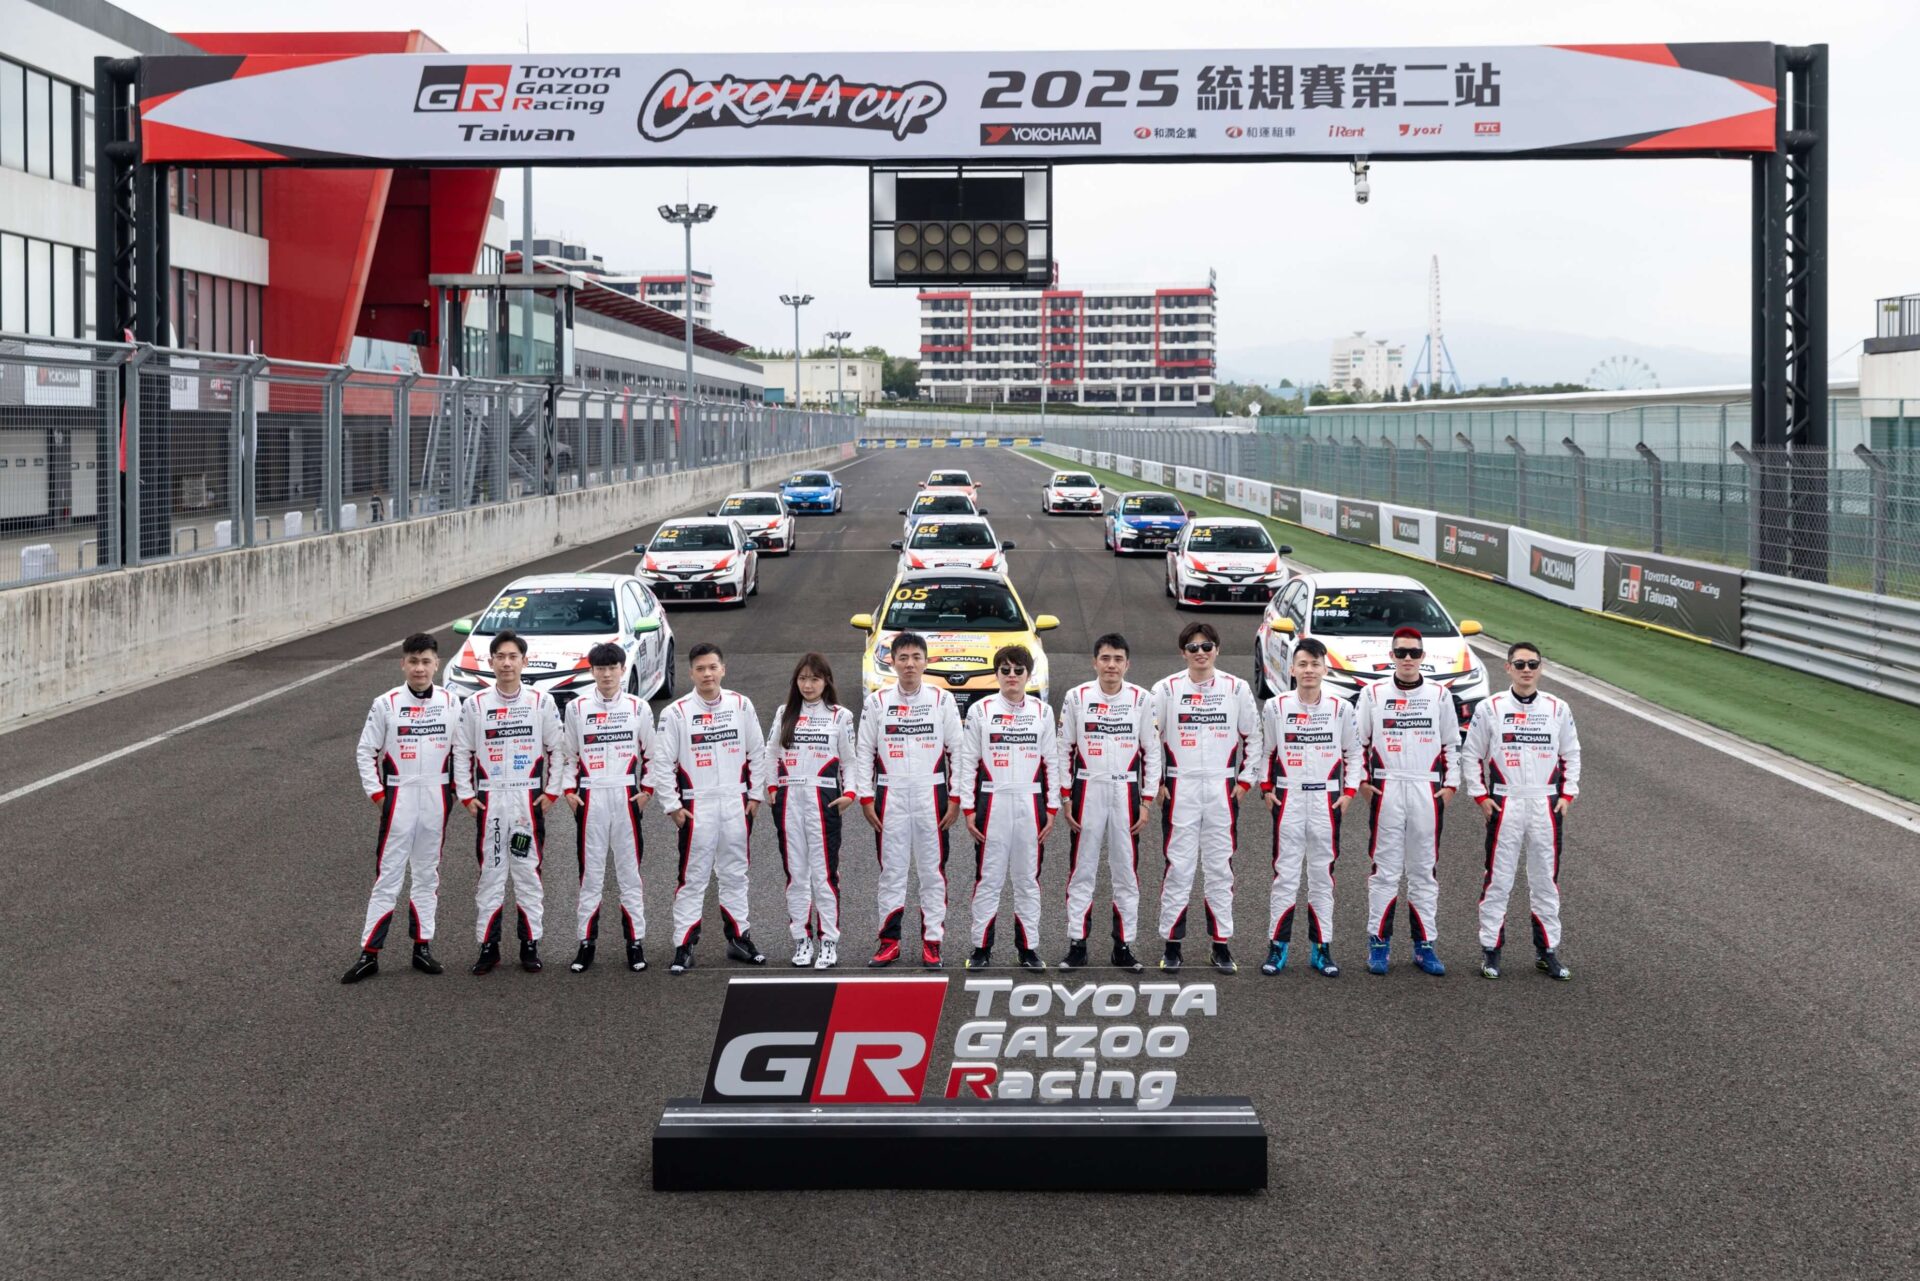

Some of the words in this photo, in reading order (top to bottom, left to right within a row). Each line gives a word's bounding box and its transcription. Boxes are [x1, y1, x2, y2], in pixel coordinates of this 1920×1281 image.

[520, 66, 621, 79] TOYOTA
[418, 83, 504, 110] GR
[516, 82, 609, 95] GAZOO
[980, 69, 1179, 109] 2025
[1196, 62, 1501, 112] 統規賽第二站
[512, 97, 605, 115] Racing
[641, 72, 841, 139] COROLLA
[848, 83, 943, 135] CUP
[458, 124, 575, 142] Taiwan
[1011, 127, 1097, 142] YOKOHAMA
[1412, 123, 1443, 136] yoxi
[896, 588, 928, 600] 05
[1620, 579, 1639, 601] GR
[1644, 570, 1669, 583] TOYOTA
[1695, 581, 1720, 599] Racing
[493, 596, 528, 609] 33
[1314, 595, 1349, 608] 24
[1644, 586, 1677, 608] Taiwan
[498, 728, 531, 736] YOKOHAMA
[964, 979, 1217, 1017] TOYOTA
[954, 1021, 1190, 1058] GAZOO
[714, 1031, 926, 1096] GR
[945, 1061, 1177, 1110] Racing
